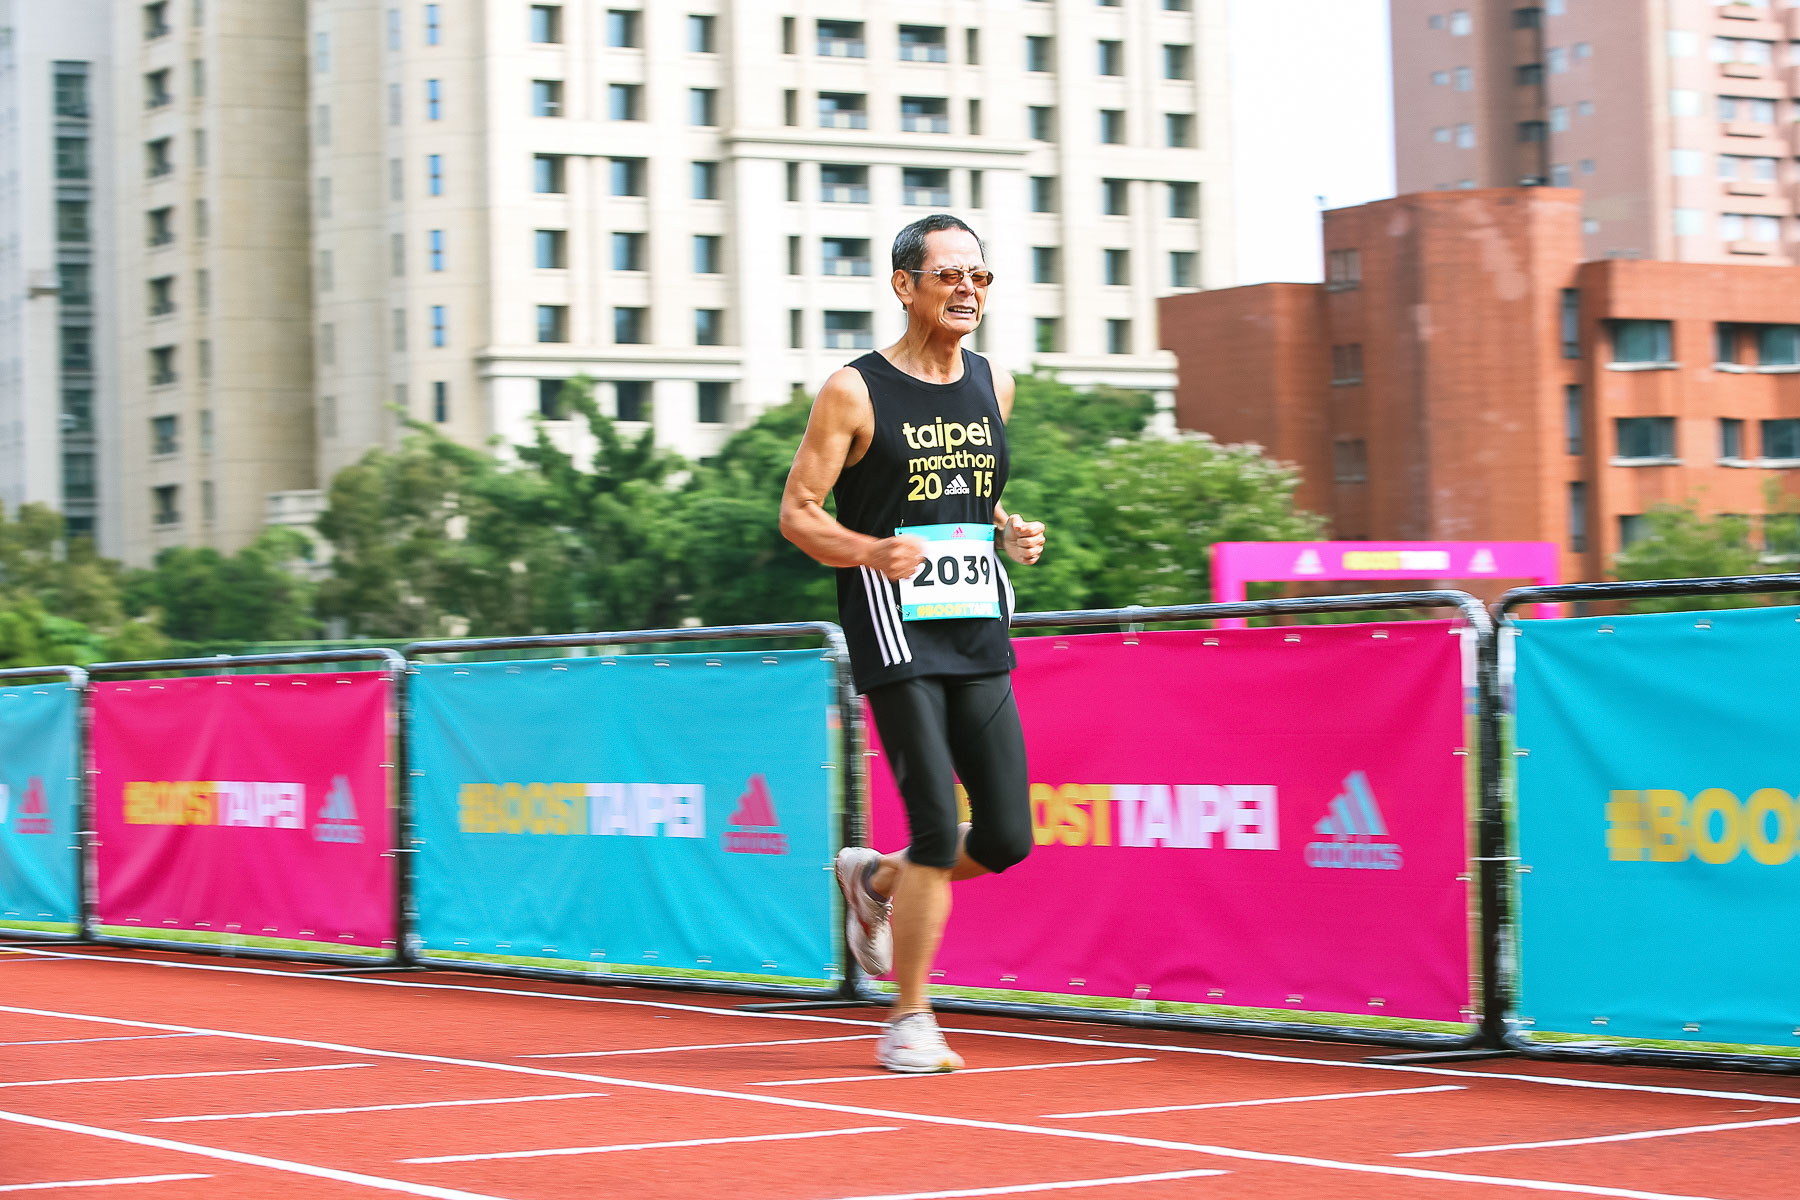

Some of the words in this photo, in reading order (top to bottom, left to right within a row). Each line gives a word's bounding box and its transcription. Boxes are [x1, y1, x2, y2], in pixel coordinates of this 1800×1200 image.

[902, 416, 992, 453] taipei
[909, 450, 995, 473] marathon
[907, 472, 943, 501] 20
[973, 471, 994, 498] 15
[913, 556, 990, 587] 2039
[122, 780, 306, 829] STTAPEI
[1604, 787, 1800, 866] #BOO
